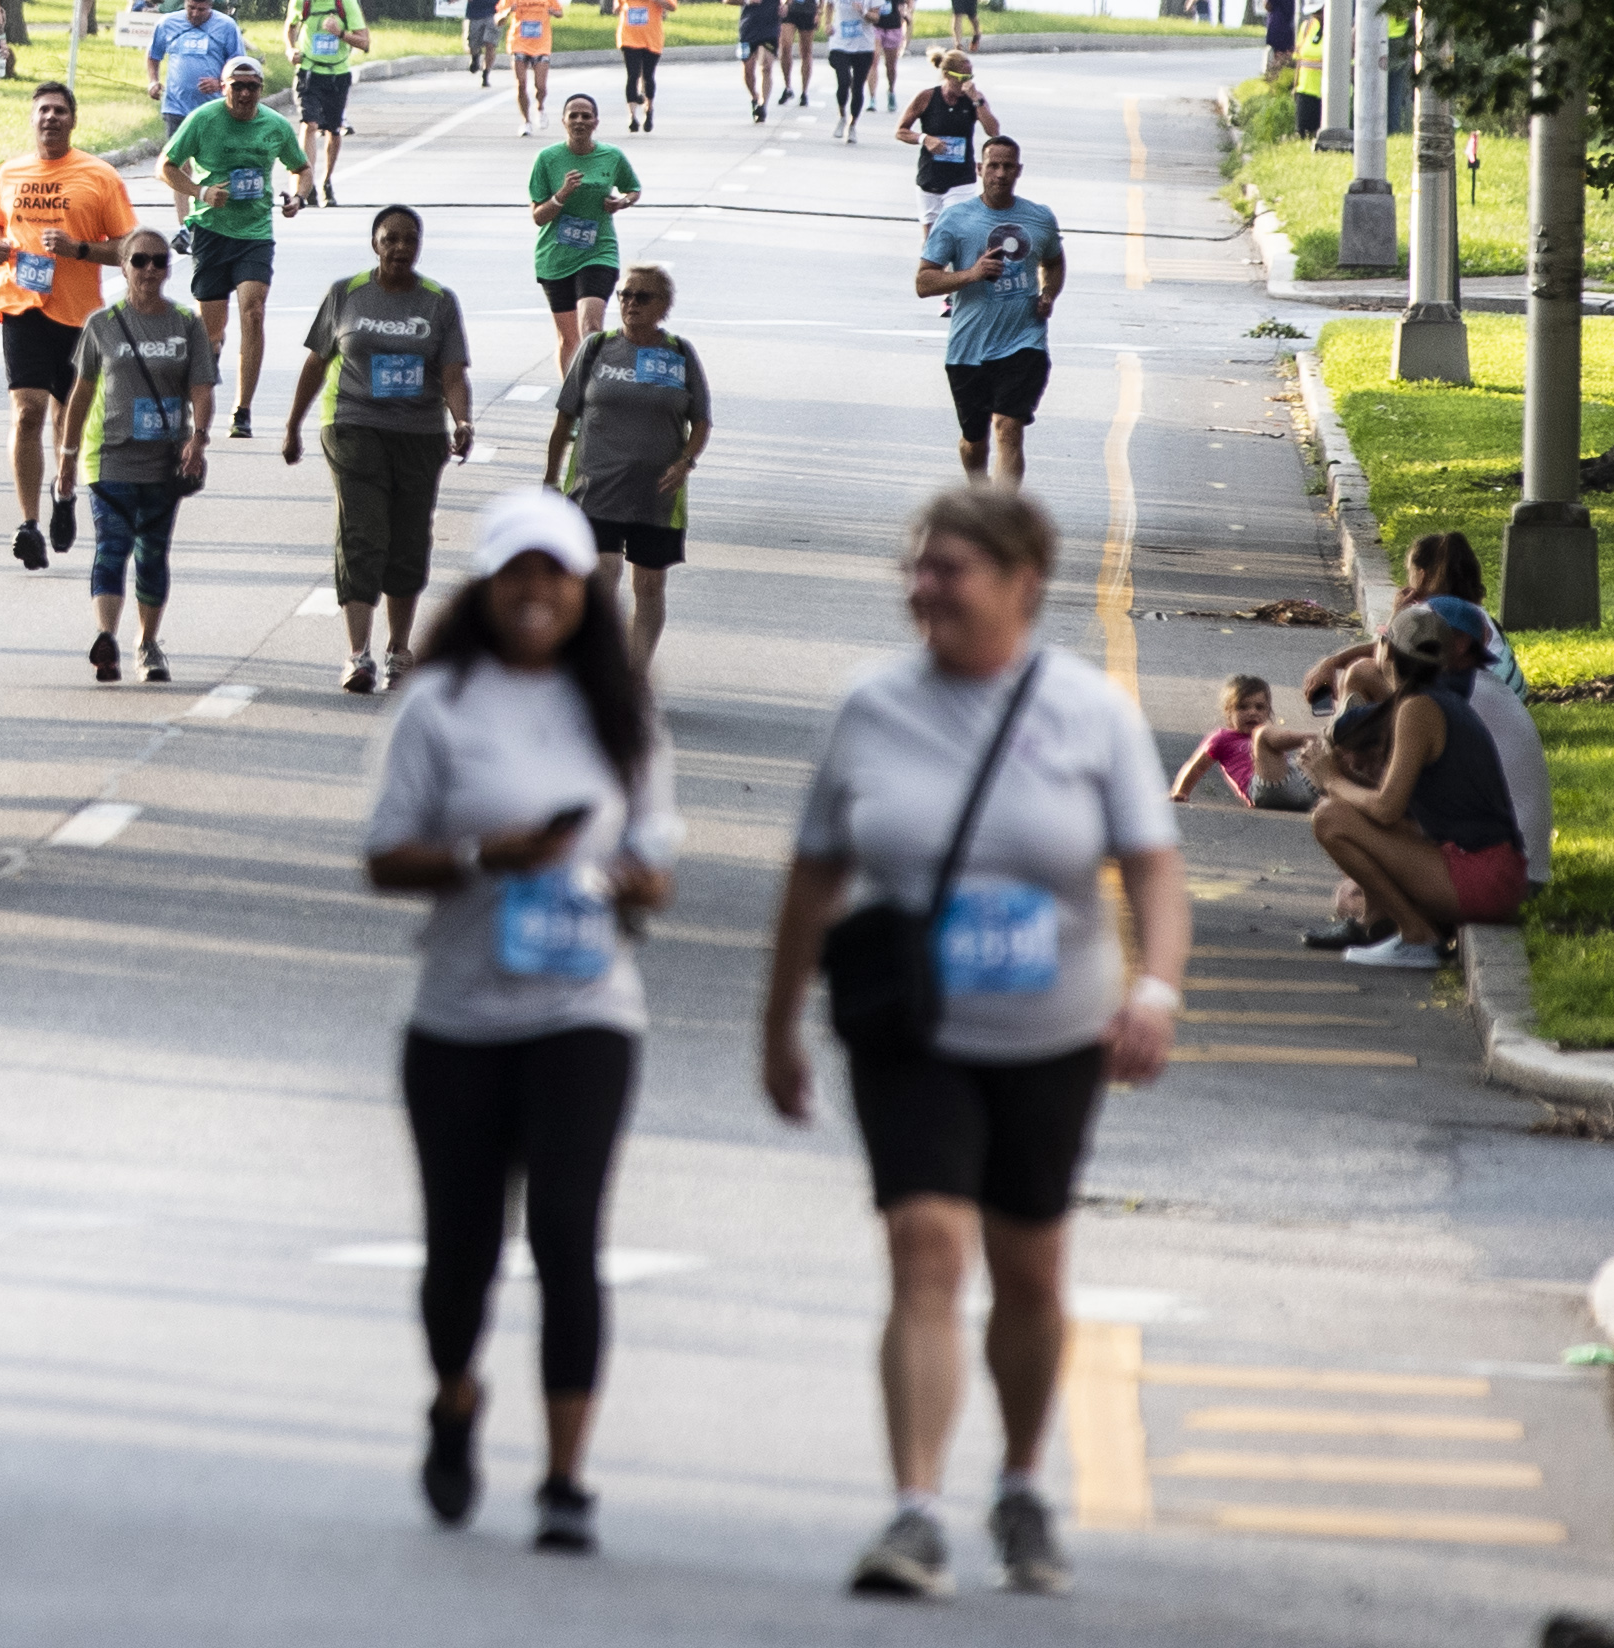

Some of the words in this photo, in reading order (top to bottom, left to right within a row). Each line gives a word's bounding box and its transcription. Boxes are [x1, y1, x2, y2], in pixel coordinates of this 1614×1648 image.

[21, 182, 63, 195] DRIVE
[236, 178, 261, 191] 479
[13, 197, 71, 210] ORANGE
[20, 266, 45, 283] 505
[994, 273, 1023, 292] 591
[381, 370, 414, 385] 542
[599, 364, 636, 383] PHe
